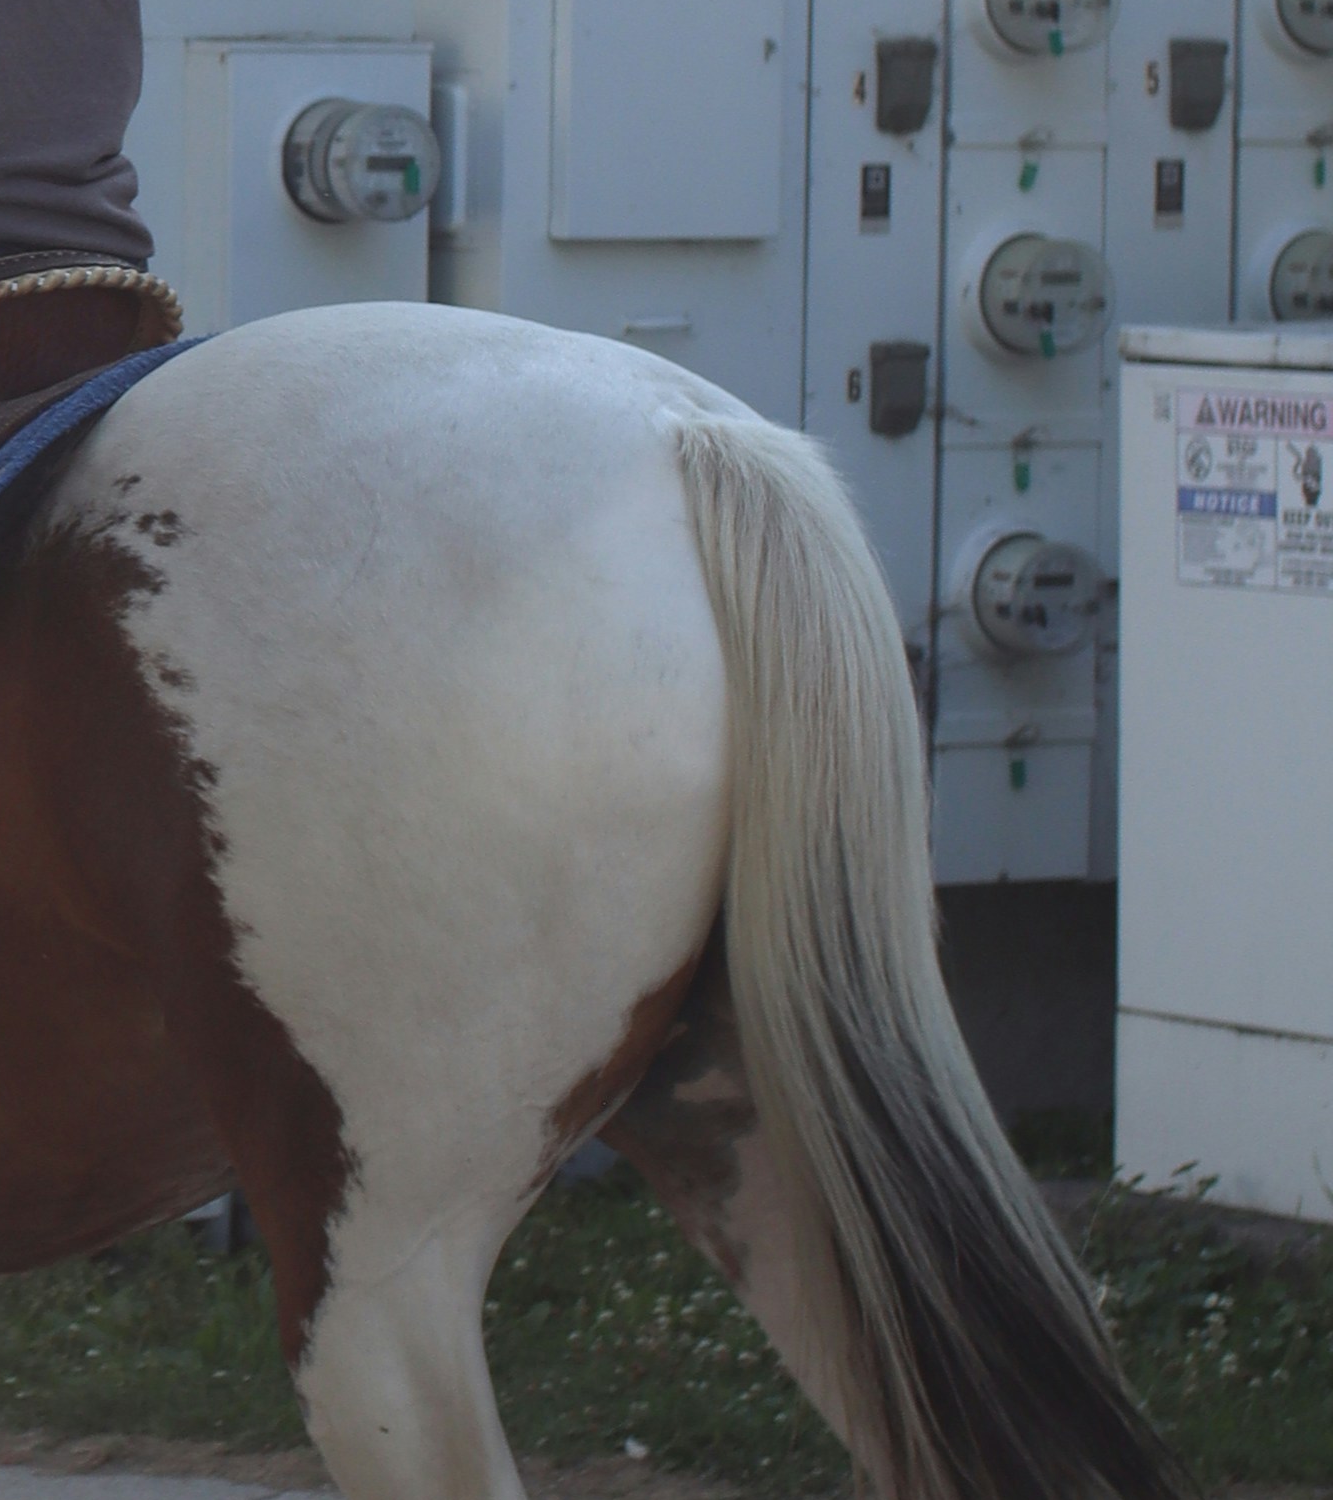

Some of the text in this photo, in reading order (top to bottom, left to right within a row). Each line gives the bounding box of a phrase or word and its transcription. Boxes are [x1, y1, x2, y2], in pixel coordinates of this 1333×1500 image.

[853, 70, 865, 104] 4
[1146, 60, 1159, 96] 5
[846, 367, 861, 403] 6
[1218, 396, 1327, 431] WARNING
[1193, 492, 1260, 513] NOTICE
[1283, 509, 1310, 526] KEEP
